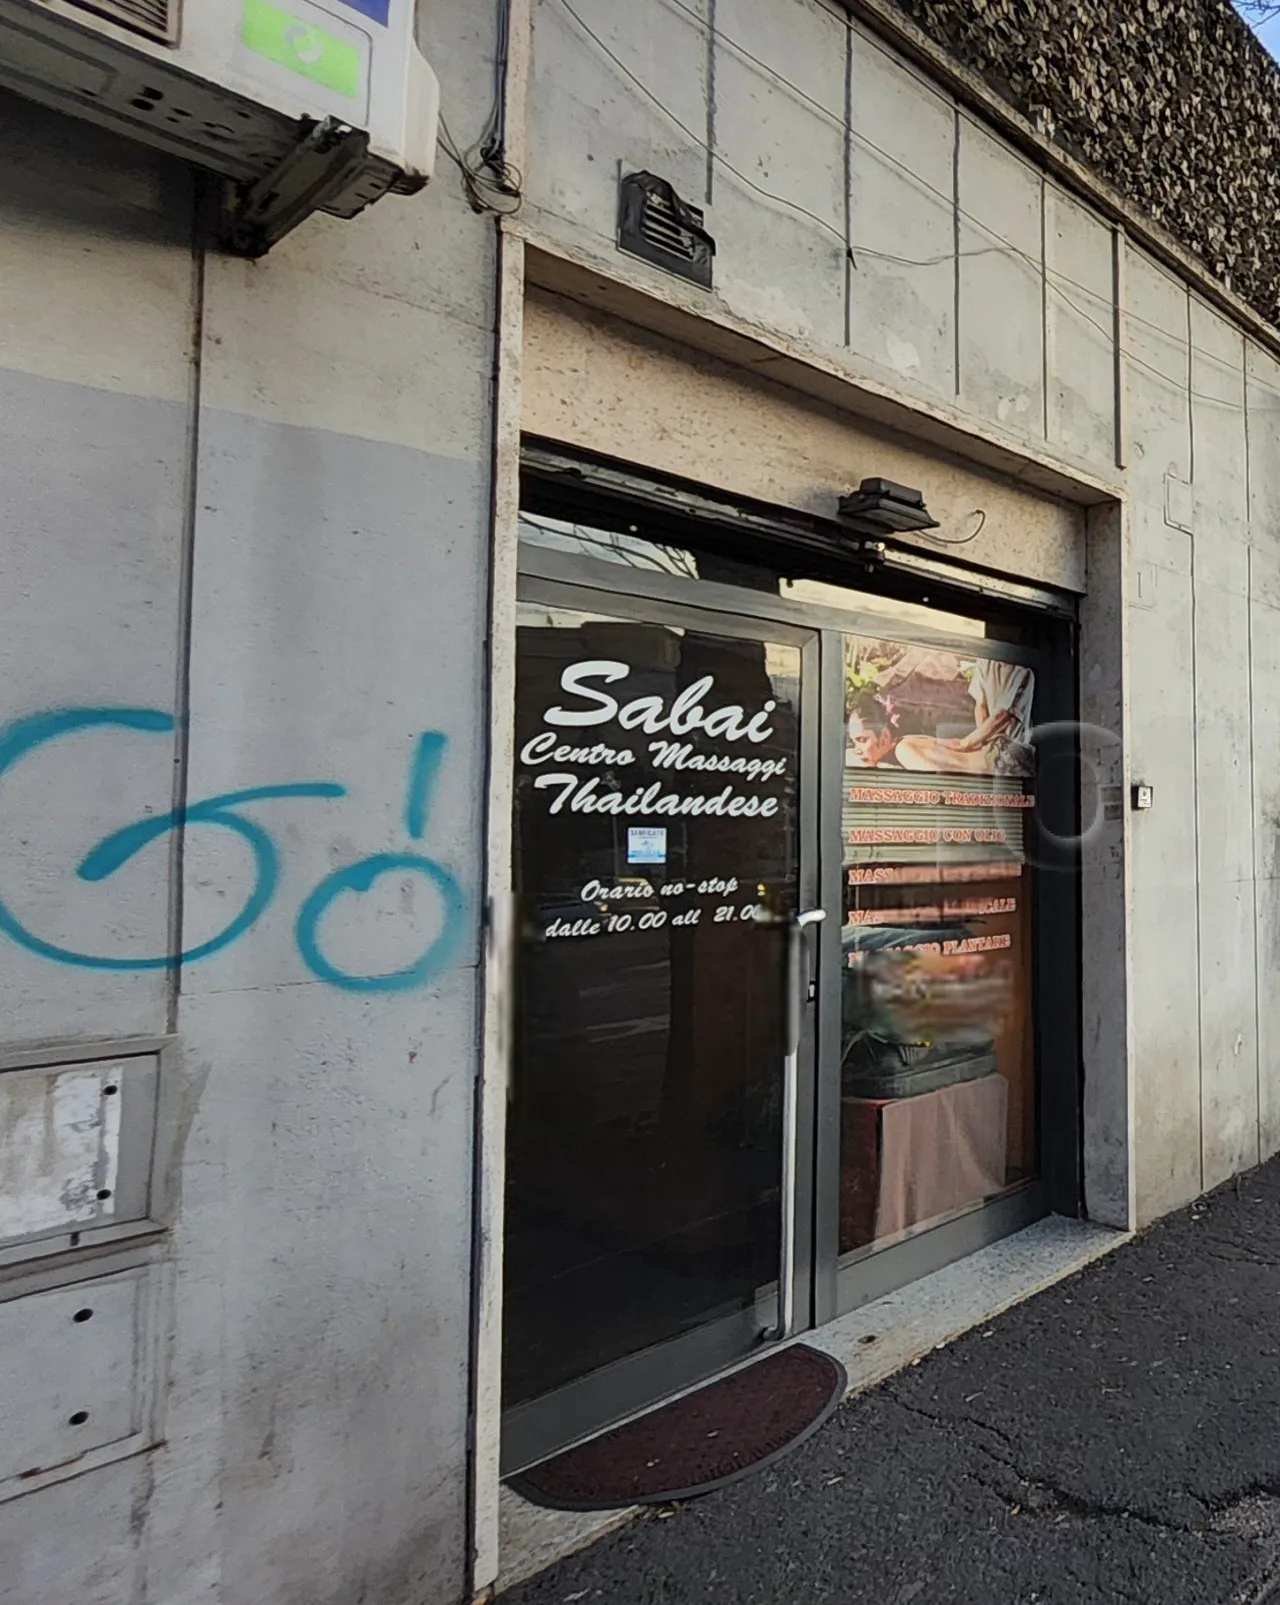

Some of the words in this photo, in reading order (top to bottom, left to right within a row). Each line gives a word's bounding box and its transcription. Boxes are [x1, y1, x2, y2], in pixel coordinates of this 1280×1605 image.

[543, 660, 777, 743] Sabai
[520, 732, 636, 766] Centro
[648, 740, 787, 782] Massaggi
[534, 773, 779, 818] Thailandese
[849, 788, 940, 804] MASSAGGIO
[849, 828, 940, 844] MASSAGGIO
[943, 828, 973, 844] CON
[580, 879, 655, 902] Orario
[659, 877, 739, 898] no-stop
[545, 917, 601, 938] dalle
[606, 911, 668, 933] 10.00
[943, 933, 1011, 955] PLANTARE
